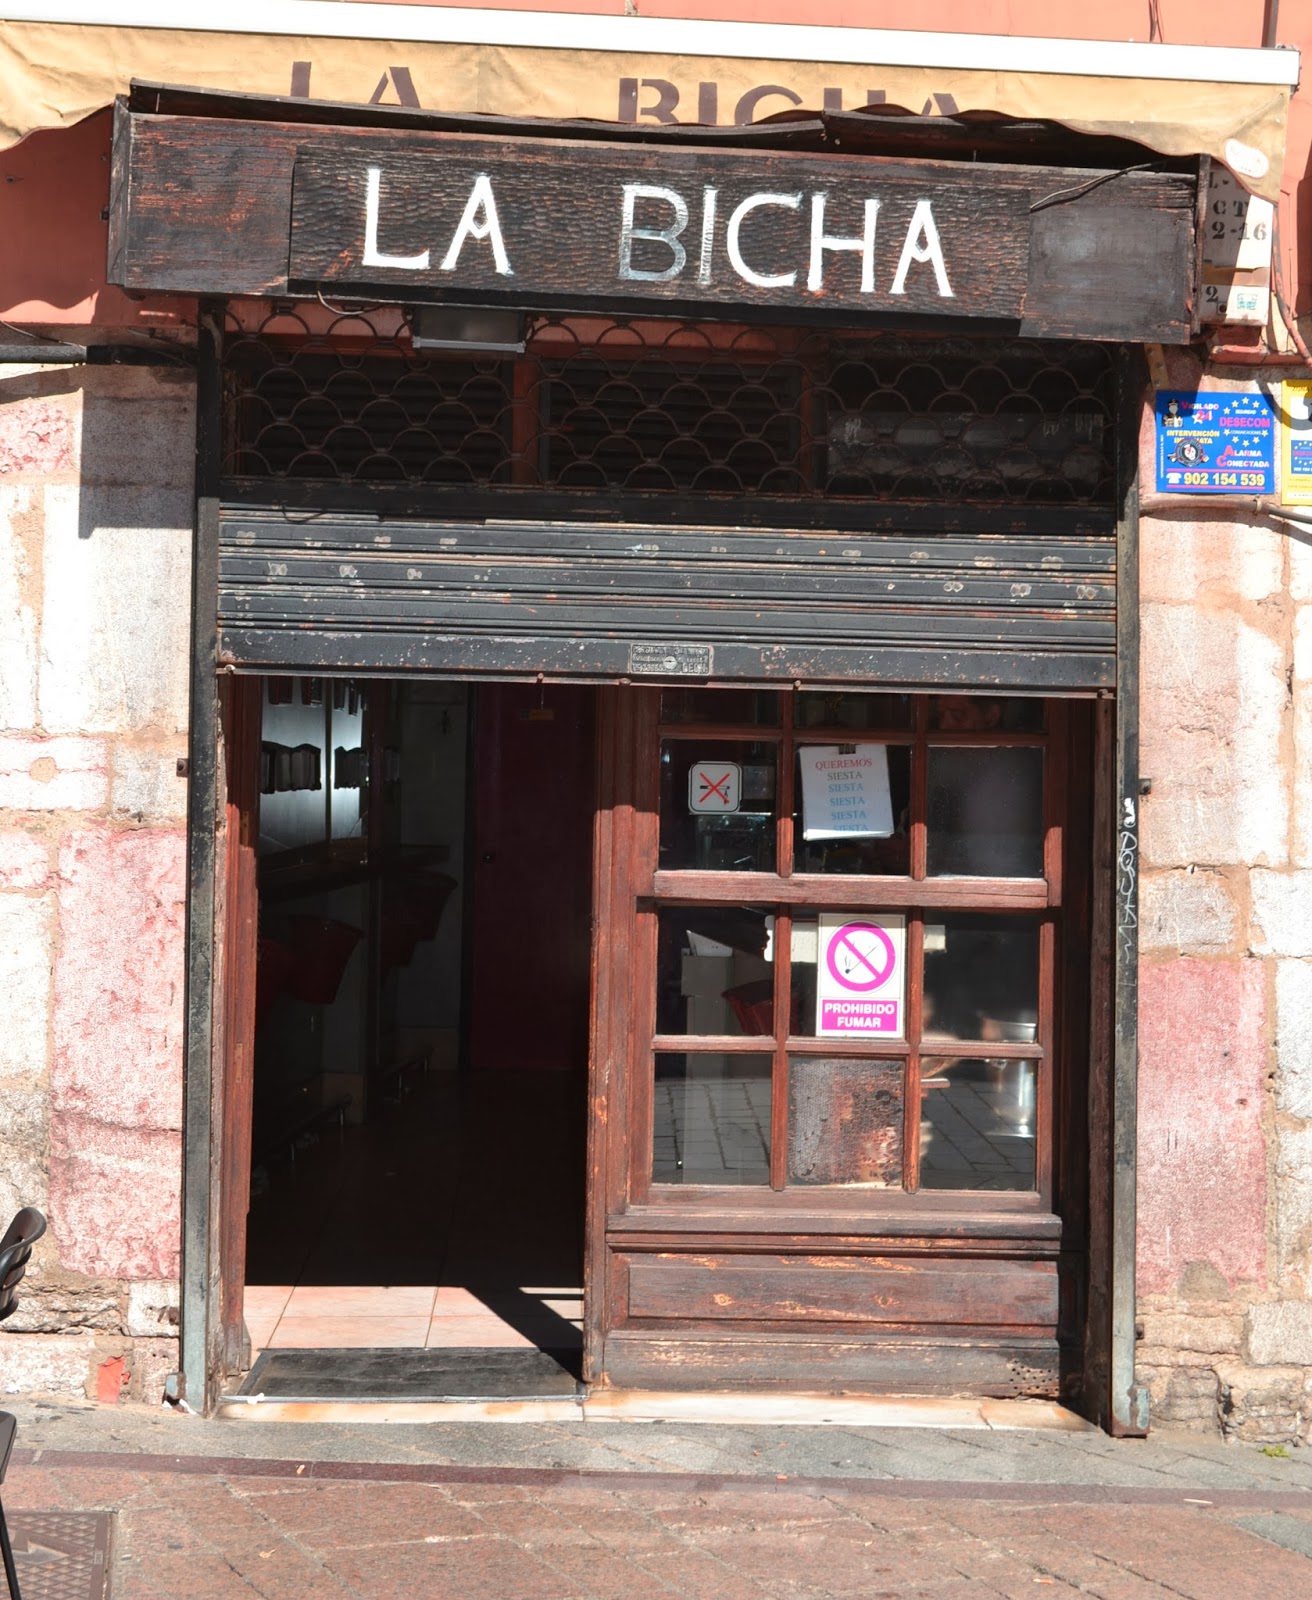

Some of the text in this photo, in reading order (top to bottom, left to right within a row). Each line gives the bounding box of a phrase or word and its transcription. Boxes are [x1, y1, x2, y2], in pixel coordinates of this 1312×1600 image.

[618, 78, 960, 125] BIC
[361, 167, 956, 298] LA BICHA
[1181, 402, 1220, 411] VIGILADO
[1219, 417, 1270, 428] DESECOM
[1166, 429, 1220, 438] INTERVENCIÓN
[1224, 445, 1262, 457] ALARMA
[1216, 455, 1270, 468] CONECTADA
[1184, 473, 1265, 486] 902 154 539
[815, 758, 873, 771] QUEREMOS
[827, 771, 863, 781] SIESTA
[828, 783, 864, 793] SIESTA
[830, 796, 865, 806] SIESTA
[831, 811, 867, 820] SIESTA
[824, 1002, 895, 1015] PROHIBIDO
[837, 1017, 882, 1028] FUMAR
